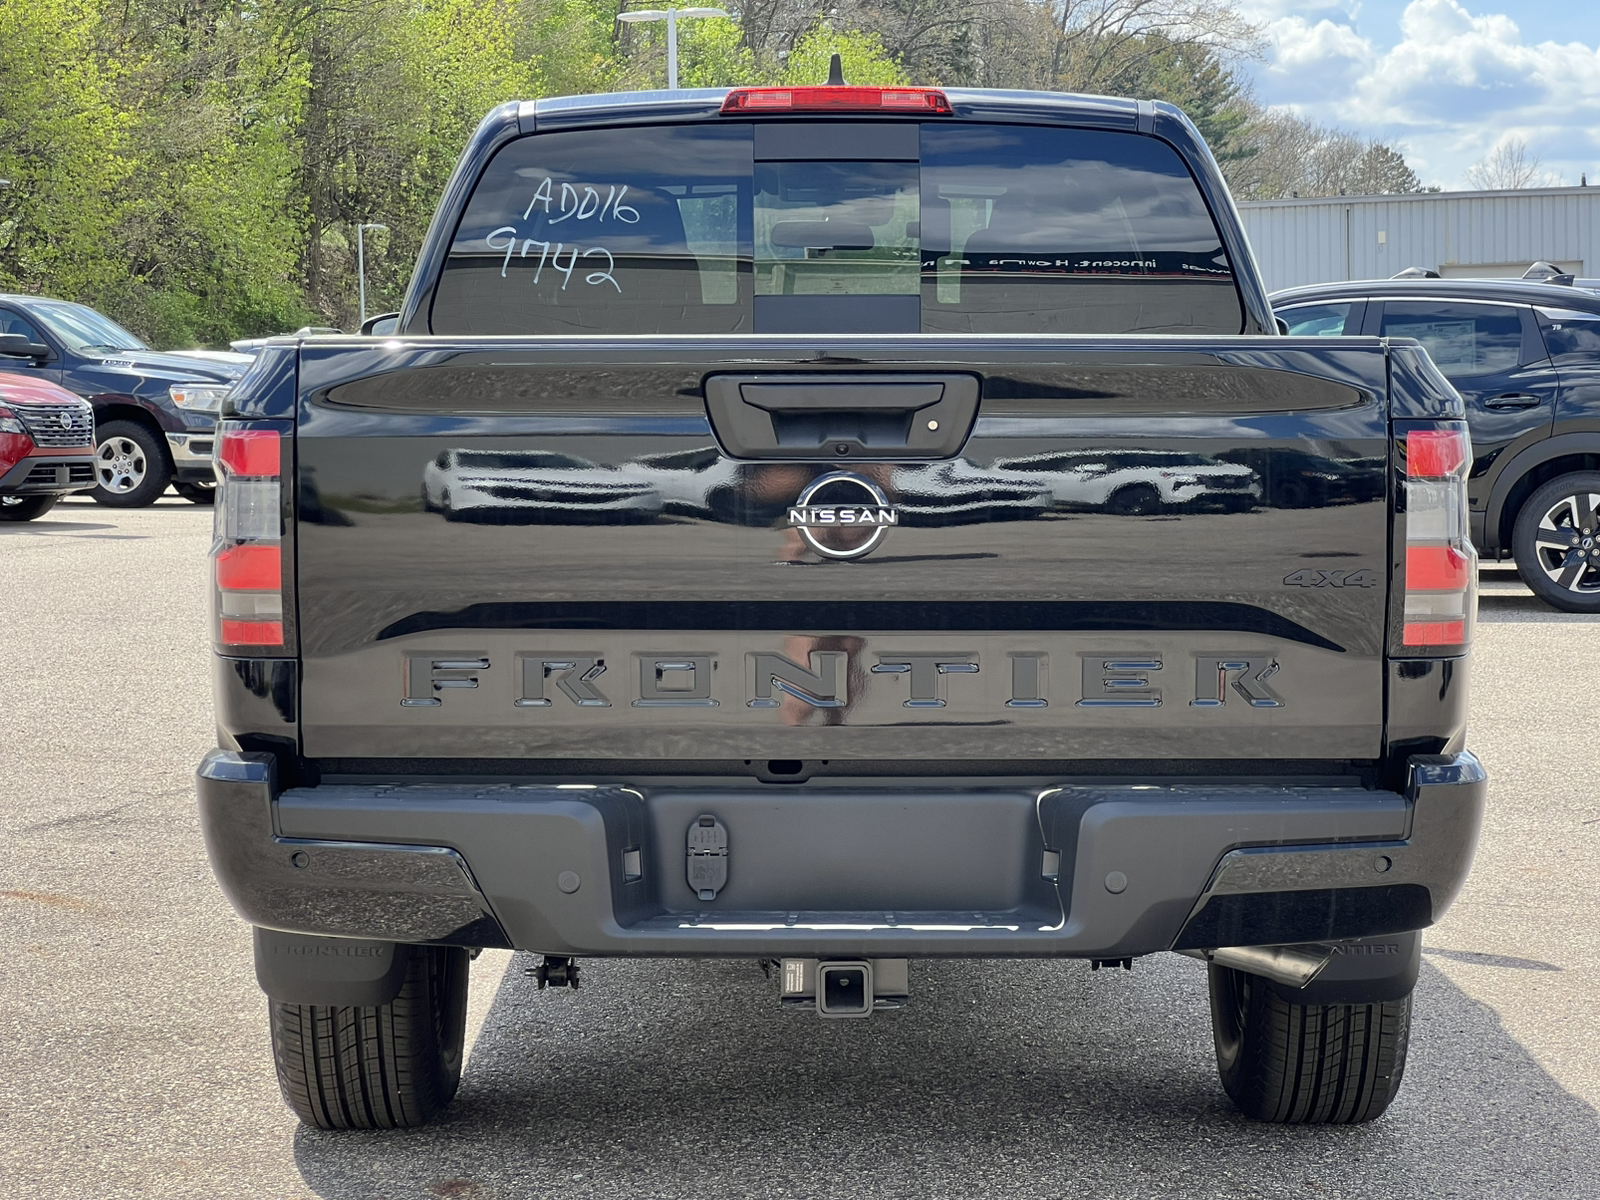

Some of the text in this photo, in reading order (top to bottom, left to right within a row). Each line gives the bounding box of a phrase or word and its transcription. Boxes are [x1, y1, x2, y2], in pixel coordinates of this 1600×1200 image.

[486, 226, 622, 293] 9742
[789, 509, 896, 523] NISSAN
[400, 650, 1286, 708] FRONTIER
[273, 944, 385, 957] FRONTIER
